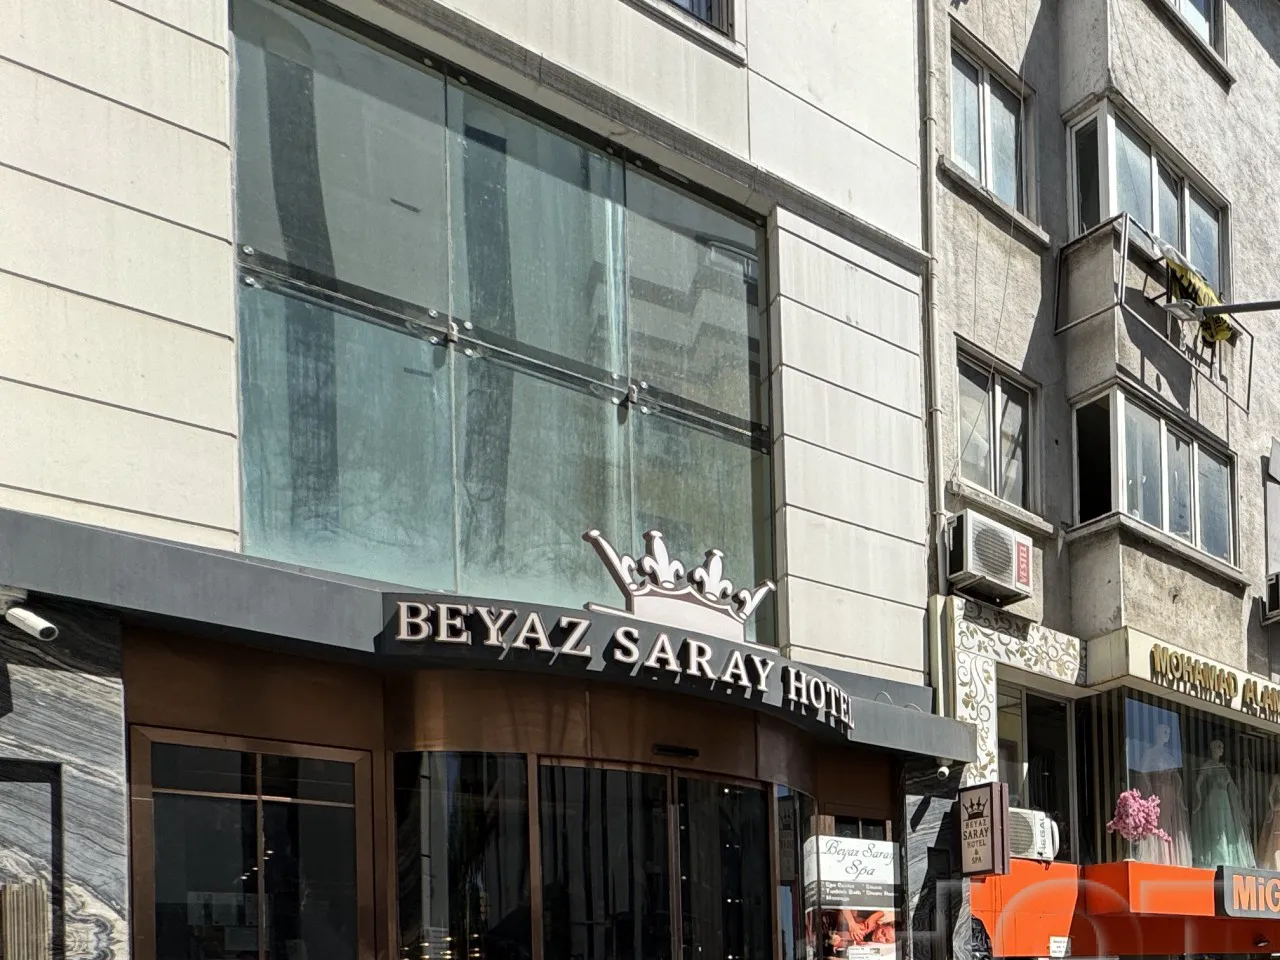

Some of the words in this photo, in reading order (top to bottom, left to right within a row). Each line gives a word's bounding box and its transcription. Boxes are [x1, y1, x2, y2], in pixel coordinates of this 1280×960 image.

[1019, 545, 1028, 583] VESTEL
[396, 600, 592, 658] BEYAZ
[613, 626, 776, 693] SARAY
[787, 665, 855, 731] HOTEL
[1152, 642, 1238, 698] MOHAMAD
[963, 827, 990, 841] SARAY
[965, 819, 988, 830] BEYAZ
[822, 839, 860, 862] Beyaz
[966, 839, 986, 849] HOTEL
[845, 859, 876, 881] Spa
[971, 856, 983, 865] SPA
